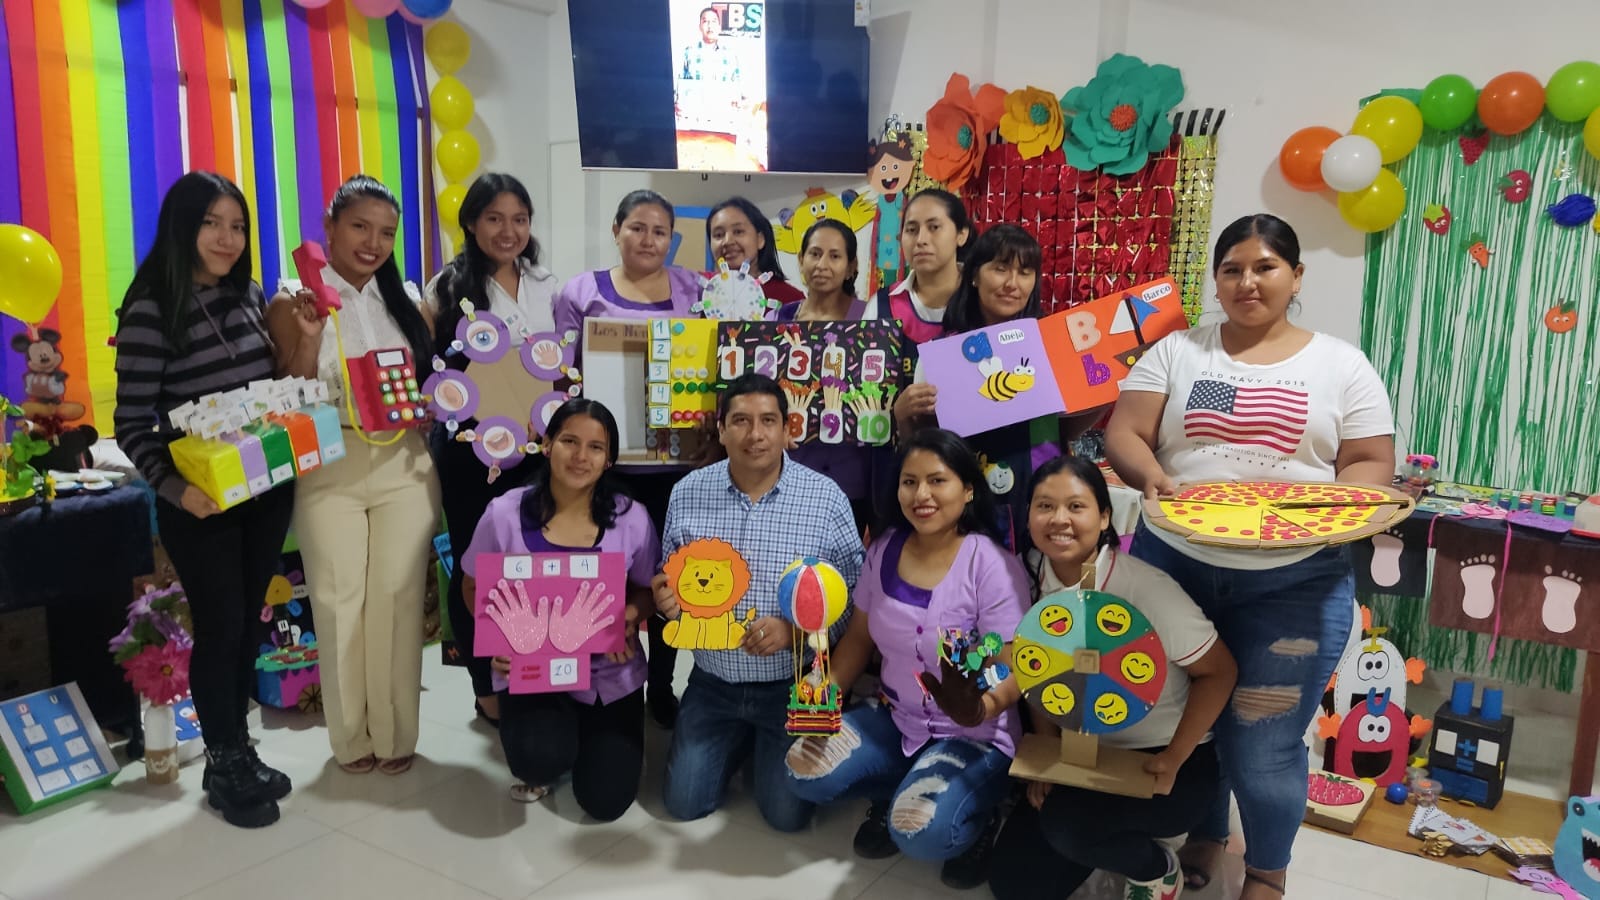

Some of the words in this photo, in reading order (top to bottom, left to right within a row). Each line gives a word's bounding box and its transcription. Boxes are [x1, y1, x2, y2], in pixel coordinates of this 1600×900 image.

[711, 3, 762, 29] TBS
[1143, 285, 1171, 302] Barco
[656, 320, 663, 334] 1
[1065, 311, 1101, 353] B
[999, 330, 1024, 343] Abeja
[657, 344, 665, 354] 2
[656, 366, 662, 376] 3
[724, 350, 737, 377] 1
[756, 350, 774, 378] 2
[789, 350, 809, 376] 3
[824, 351, 843, 379] 4
[864, 355, 883, 382] 5
[1081, 353, 1112, 387] b
[1201, 370, 1224, 379] OLD
[1230, 375, 1263, 383] NAVY
[657, 386, 665, 399] 4
[656, 408, 664, 422] 5
[788, 412, 804, 438] 8
[822, 413, 841, 439] 9
[859, 415, 890, 439] 10
[515, 561, 523, 573] 6
[554, 663, 572, 676] 10
